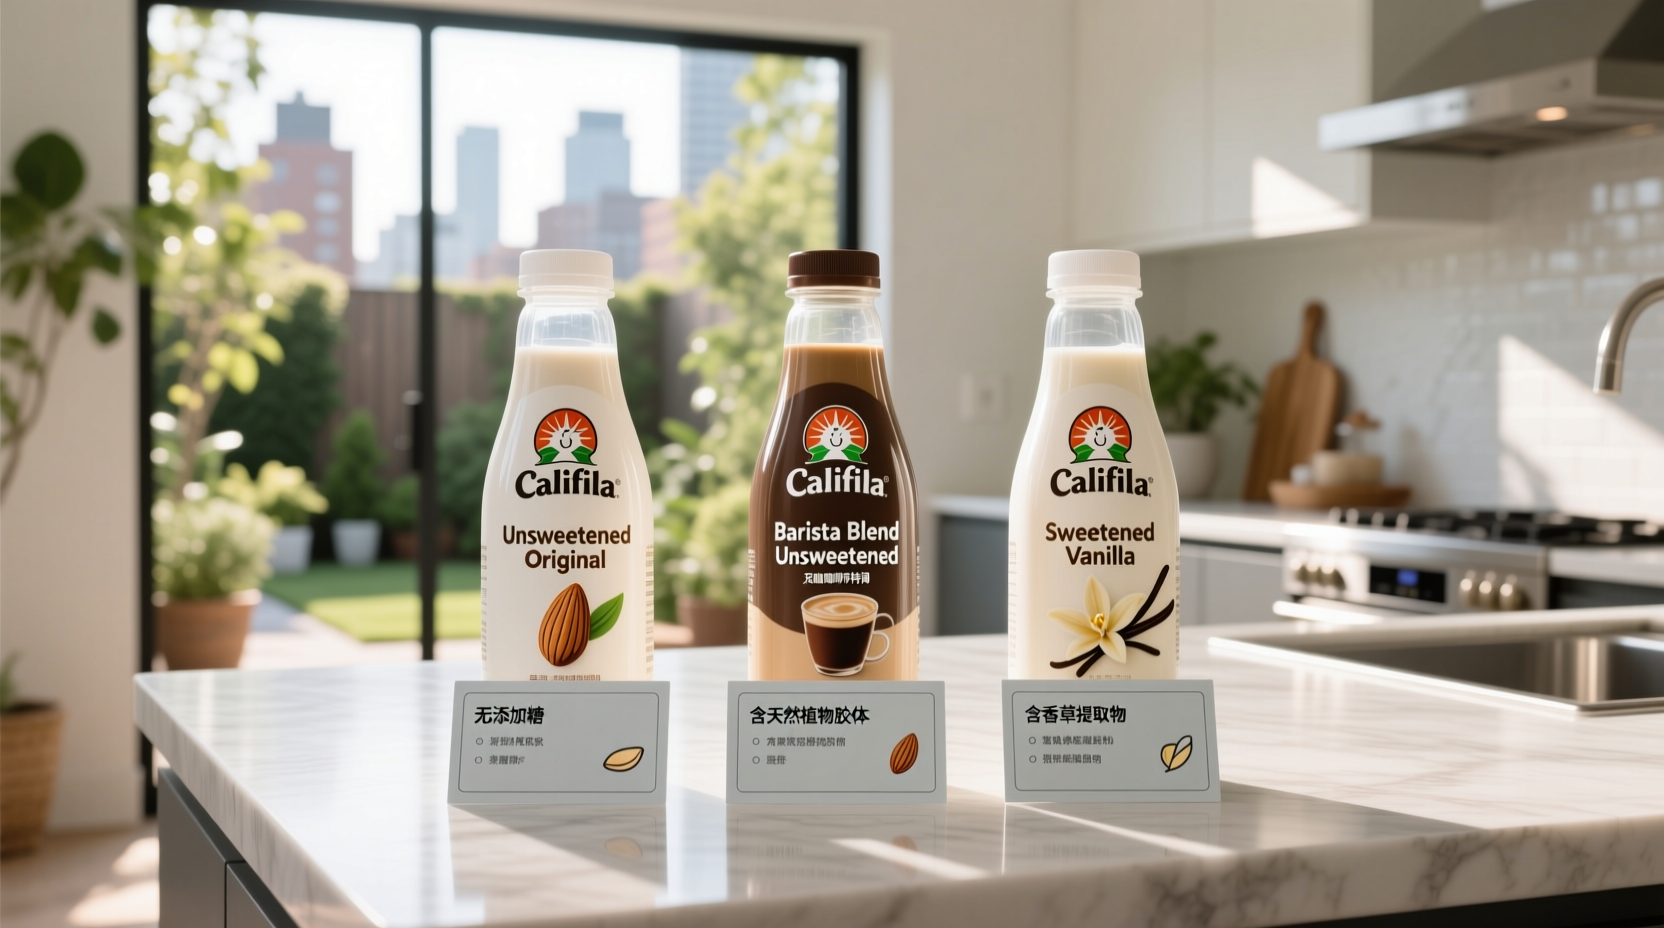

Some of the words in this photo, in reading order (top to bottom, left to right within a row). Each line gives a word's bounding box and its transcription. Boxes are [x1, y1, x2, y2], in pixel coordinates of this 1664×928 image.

[515, 468, 615, 499] Califila
[786, 465, 885, 497] Califila
[1050, 466, 1149, 497] Califila
[503, 524, 631, 545] Unsweetened
[774, 521, 841, 541] Barista
[847, 520, 900, 541] Blend
[1045, 522, 1155, 542] Sweetened
[524, 549, 606, 574] Original
[775, 545, 899, 565] Unsweetened
[1065, 545, 1136, 566] Vanilla
[474, 705, 545, 725] 无添加糖
[750, 705, 870, 725] 含天然植物胶体
[1025, 704, 1127, 724] 含香草提取物
